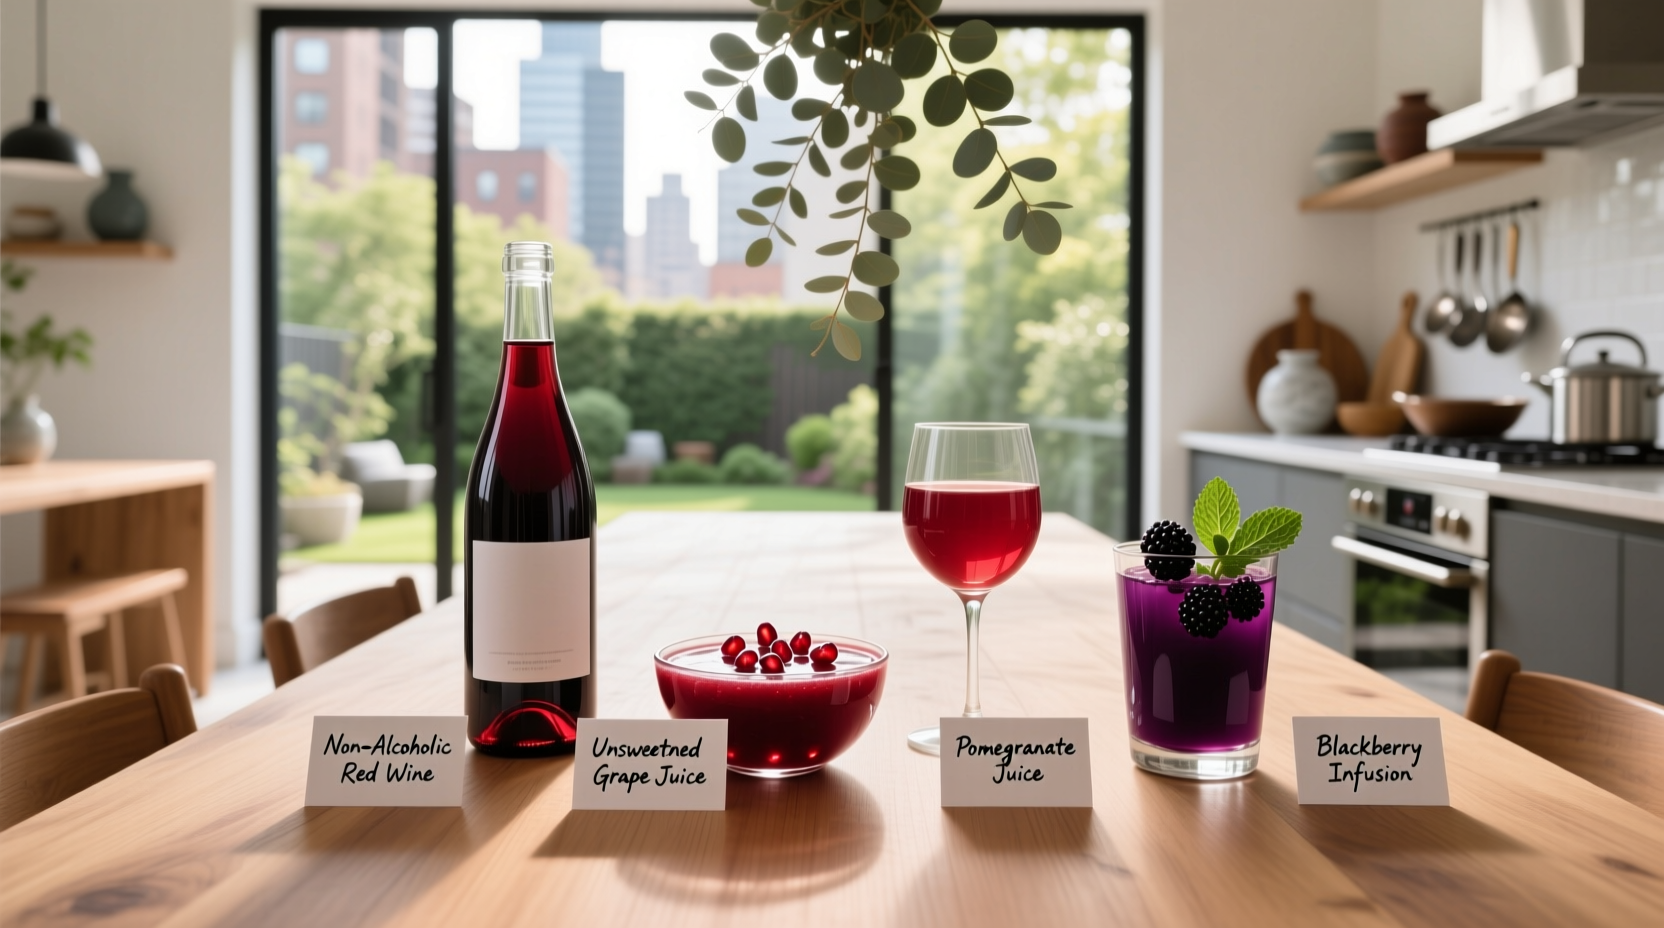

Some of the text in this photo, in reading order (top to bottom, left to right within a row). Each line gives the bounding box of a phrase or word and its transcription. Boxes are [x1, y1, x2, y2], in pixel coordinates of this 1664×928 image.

[323, 733, 452, 756] Non-Alcoholic
[592, 736, 702, 758] Unsweetned
[955, 736, 1077, 766] Pomegranate
[1316, 734, 1423, 767] Blackberry
[340, 761, 435, 784] Red Wine
[593, 764, 707, 793] Grape Juice
[991, 765, 1045, 784] Juice
[1327, 761, 1413, 792] Infusion
